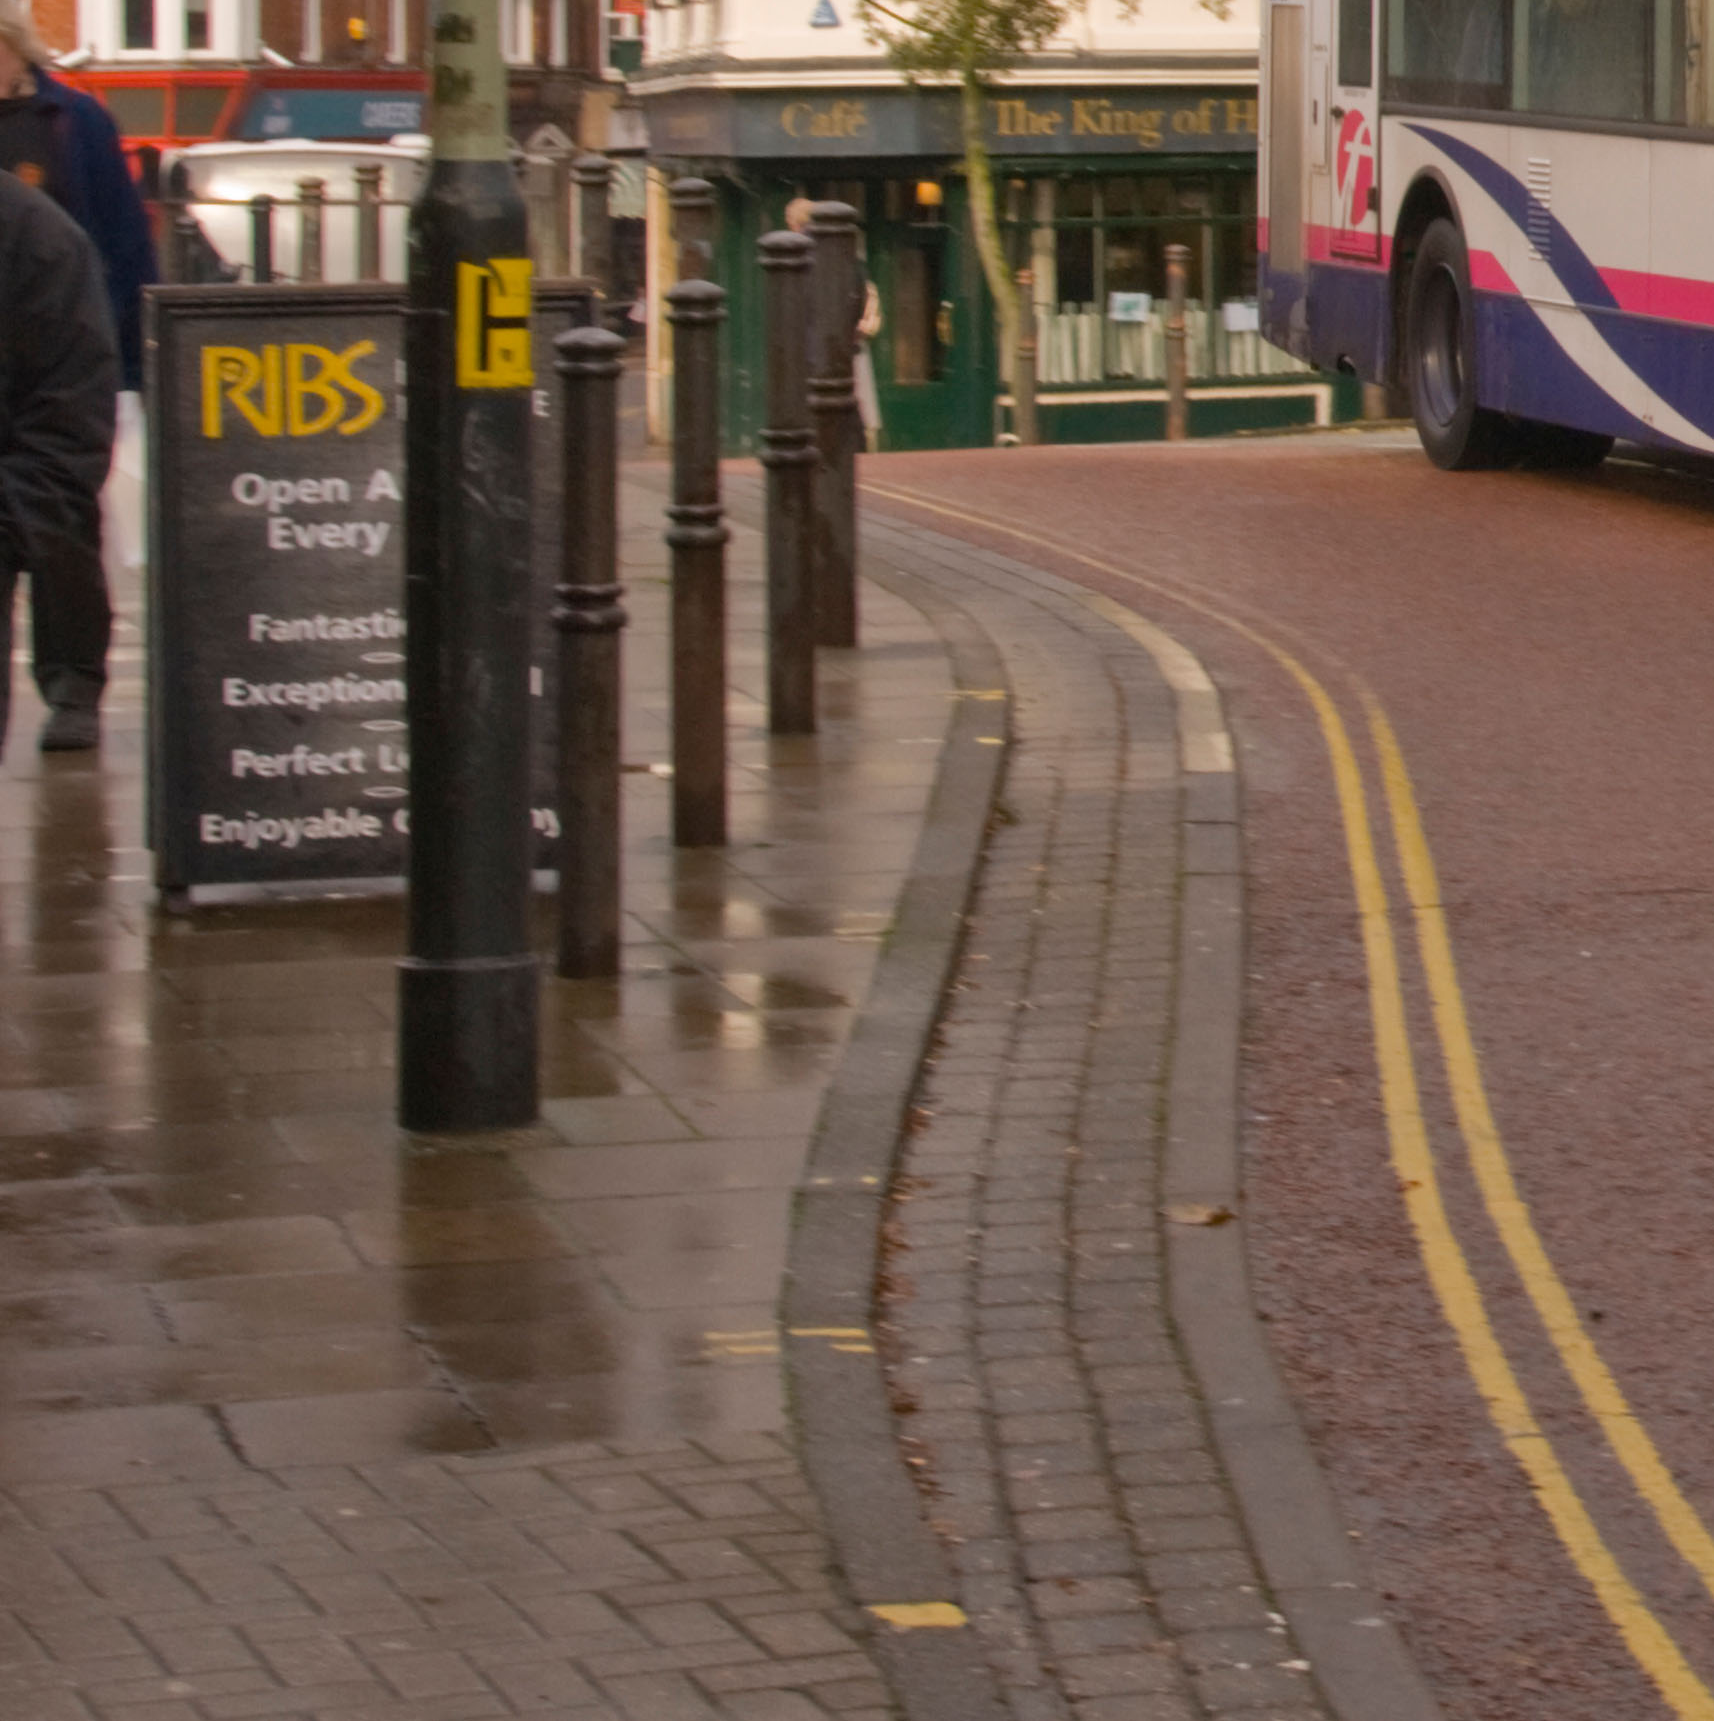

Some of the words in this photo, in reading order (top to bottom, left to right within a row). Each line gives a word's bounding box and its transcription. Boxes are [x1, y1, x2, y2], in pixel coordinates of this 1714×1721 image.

[781, 98, 867, 138] Café
[988, 99, 1064, 136] The
[1070, 99, 1166, 148] King
[1171, 98, 1217, 136] of
[201, 339, 386, 439] RIBS
[231, 471, 349, 511] Open
[267, 516, 391, 556] Every
[231, 744, 366, 778] Perfect
[200, 807, 382, 849] Enjoyable
